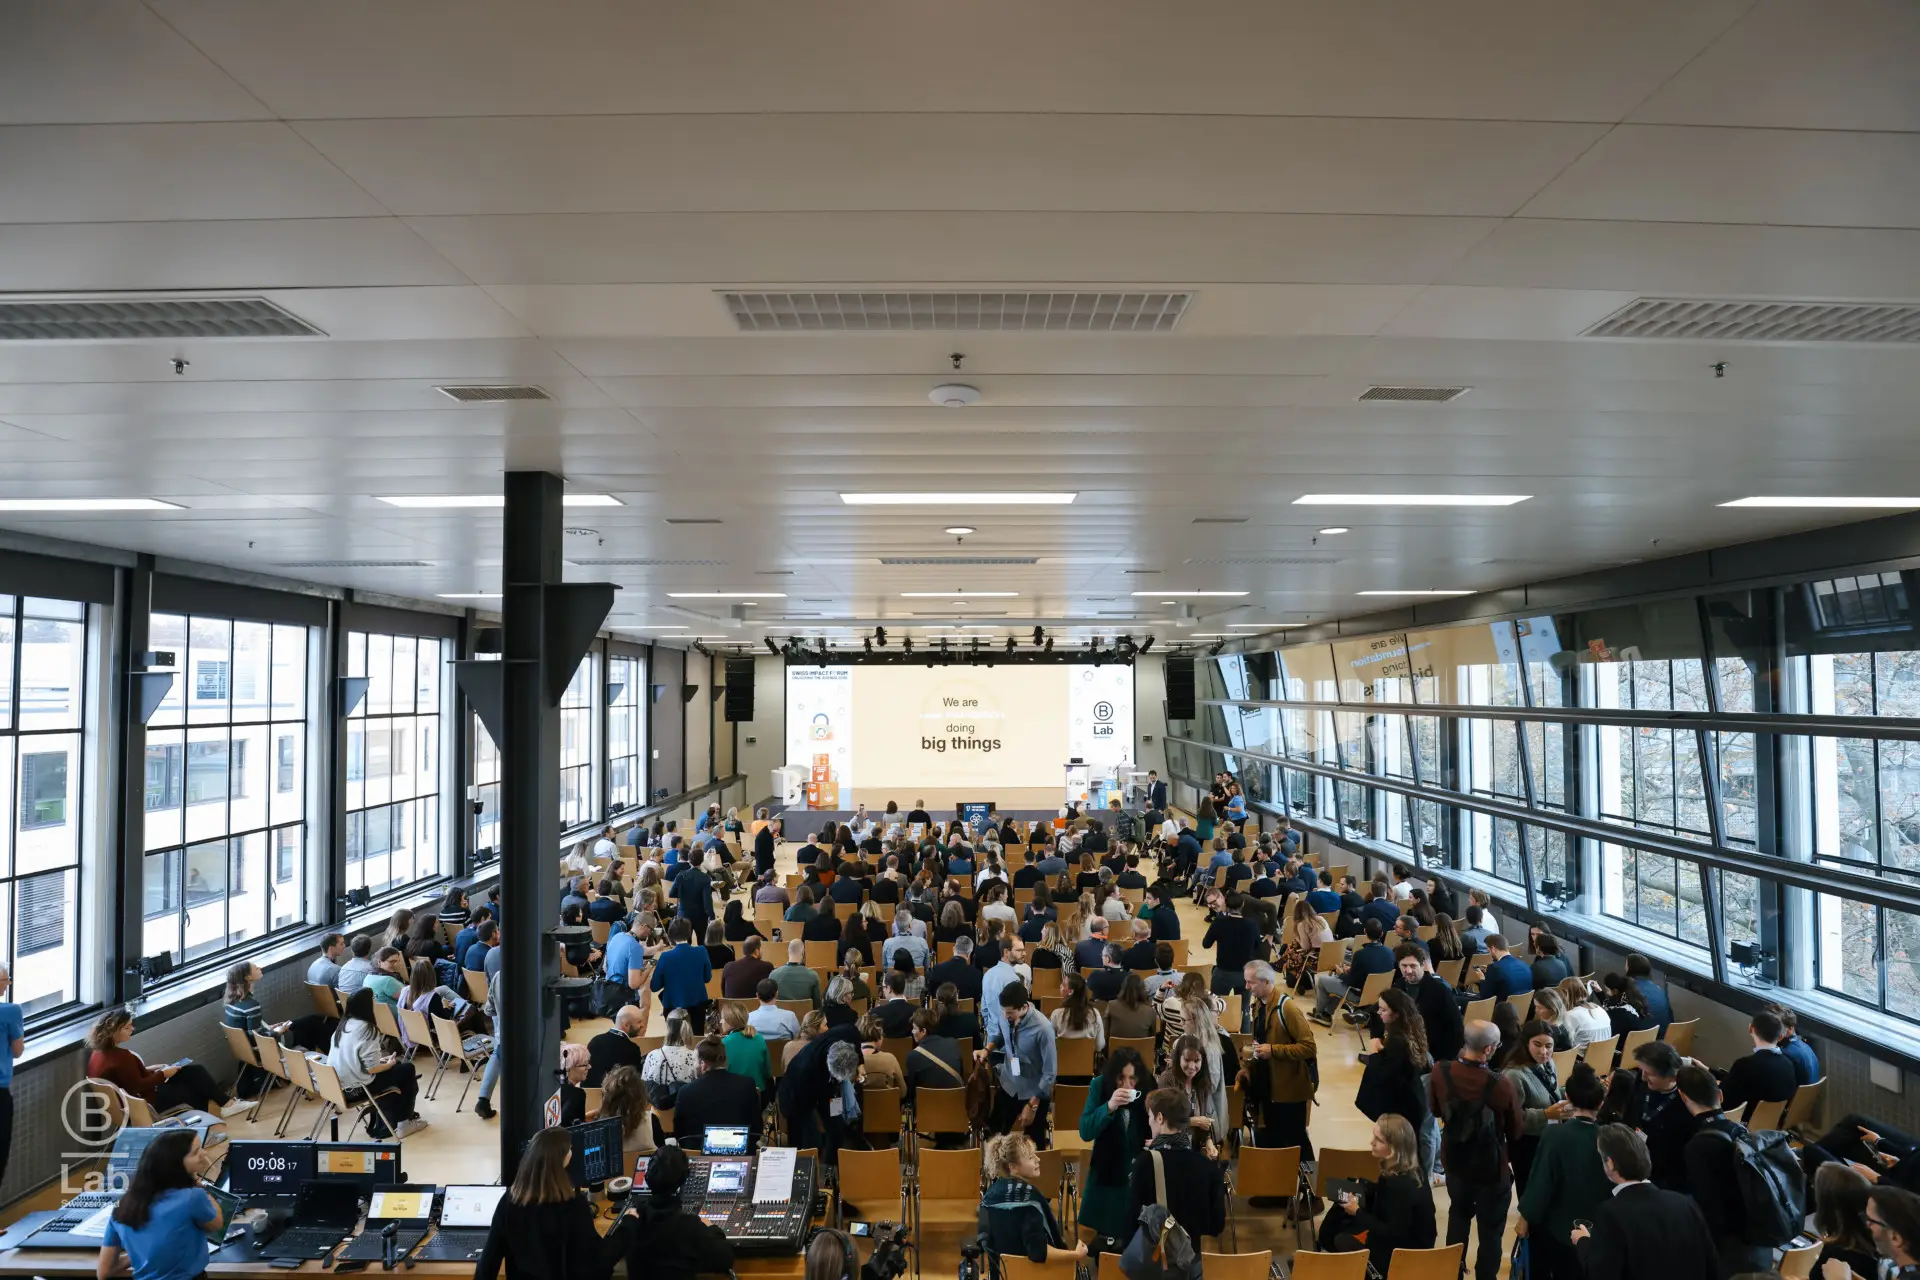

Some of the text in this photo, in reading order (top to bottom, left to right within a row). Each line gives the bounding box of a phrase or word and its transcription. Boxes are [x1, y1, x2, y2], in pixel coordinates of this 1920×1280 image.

[943, 697, 978, 707] We are
[946, 723, 975, 735] doing
[1094, 726, 1114, 735] Lab
[921, 736, 1002, 753] big things
[248, 1157, 298, 1171] 09:08 17
